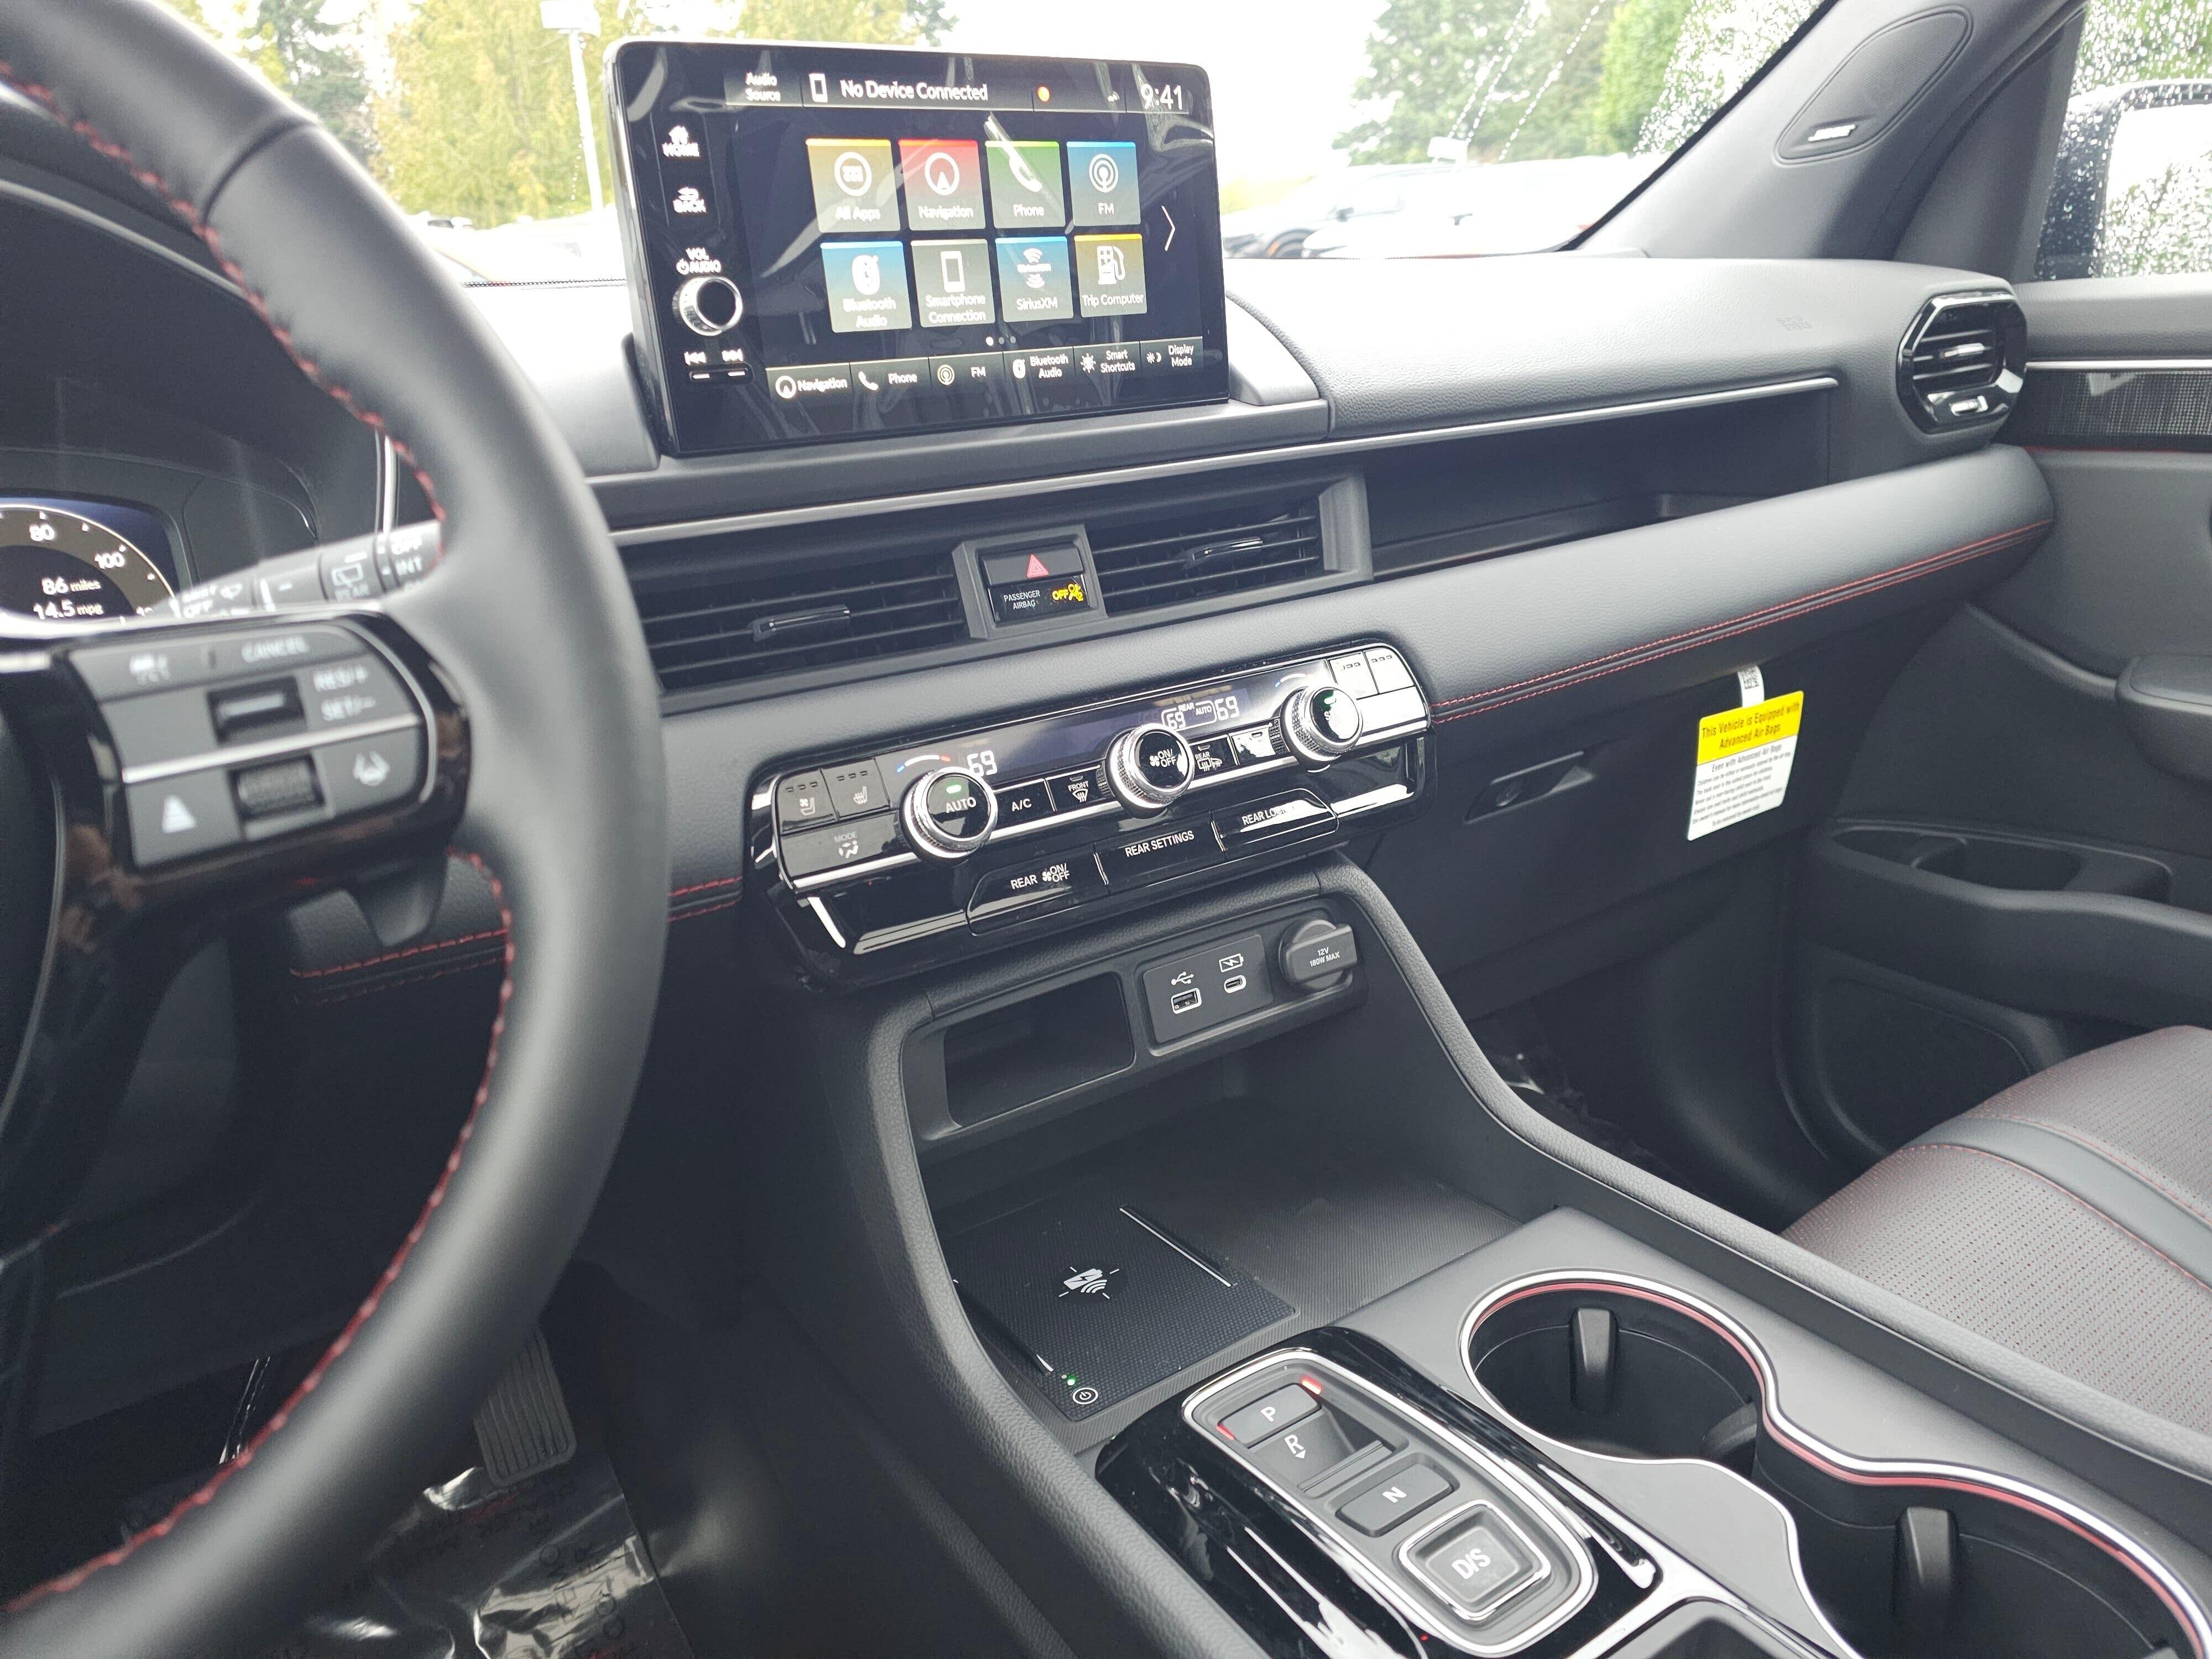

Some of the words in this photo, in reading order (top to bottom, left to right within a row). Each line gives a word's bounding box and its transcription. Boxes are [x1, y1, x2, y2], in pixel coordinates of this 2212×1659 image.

[745, 72, 777, 87] Audio
[745, 88, 781, 102] Source
[840, 80, 864, 98] No
[865, 80, 915, 100] Device
[916, 82, 988, 101] Connected
[1140, 84, 1183, 110] 9:41
[672, 199, 707, 213] BACK
[917, 205, 974, 220] Navigation
[1013, 204, 1045, 217] Phone
[1098, 202, 1115, 216] FM
[853, 207, 881, 222] Apps
[686, 247, 709, 262] VOL
[689, 258, 721, 274] AUDIO
[842, 298, 897, 313] Bluetooth
[925, 293, 987, 309] Smartphone
[1016, 297, 1058, 311] SiriusXM
[1082, 294, 1099, 307] Trip
[1100, 293, 1144, 308] Computer
[855, 313, 888, 329] Audio
[928, 309, 987, 324] Connection
[1105, 349, 1128, 362] Smart
[1167, 343, 1194, 357] Display
[1030, 353, 1069, 367] Bluetooth
[1100, 361, 1136, 374] Shortcuts
[1171, 356, 1193, 367] Mode
[888, 372, 917, 385] Phone
[971, 367, 986, 378] FM
[1038, 367, 1063, 379] Audio
[797, 377, 848, 393] Navigation
[29, 524, 55, 542] 80
[94, 552, 125, 570] 100
[41, 576, 69, 596] 86
[70, 577, 102, 592] miles
[1003, 589, 1041, 602] PASSENGER
[1052, 589, 1069, 601] OFF
[33, 599, 76, 620] 14.5
[77, 603, 104, 617] mpg
[1013, 599, 1036, 610] AIRBAG
[1178, 702, 1194, 713] REAR
[1195, 705, 1213, 717] AUTO
[1217, 696, 1239, 721] 69
[1702, 726, 1717, 739] This
[1719, 719, 1744, 735] Vehicle
[1746, 714, 1752, 726] is
[1755, 707, 1784, 724] Equipped
[1787, 701, 1800, 713] with
[1719, 734, 1751, 749] Advanced
[1754, 728, 1763, 739] Air
[1765, 723, 1780, 735] Bags
[967, 750, 998, 776] 69
[1160, 757, 1176, 768] OFF
[1195, 751, 1210, 761] REAR
[1067, 780, 1089, 792] FRONT
[945, 796, 977, 813] AUTO
[1011, 797, 1032, 813] A/C
[1242, 811, 1265, 825] REAR
[833, 831, 858, 844] MODE
[1125, 842, 1150, 857] REAR
[1151, 831, 1194, 852] SETTINGS
[1010, 874, 1038, 890] REAR
[1051, 870, 1071, 883] OFF
[1310, 956, 1325, 967] 180W
[1326, 951, 1340, 962] MAX
[1318, 947, 1329, 956] 12V
[1260, 1406, 1276, 1422] P
[1285, 1434, 1303, 1453] R
[1383, 1486, 1407, 1503] N
[1451, 1547, 1491, 1580] D/S
